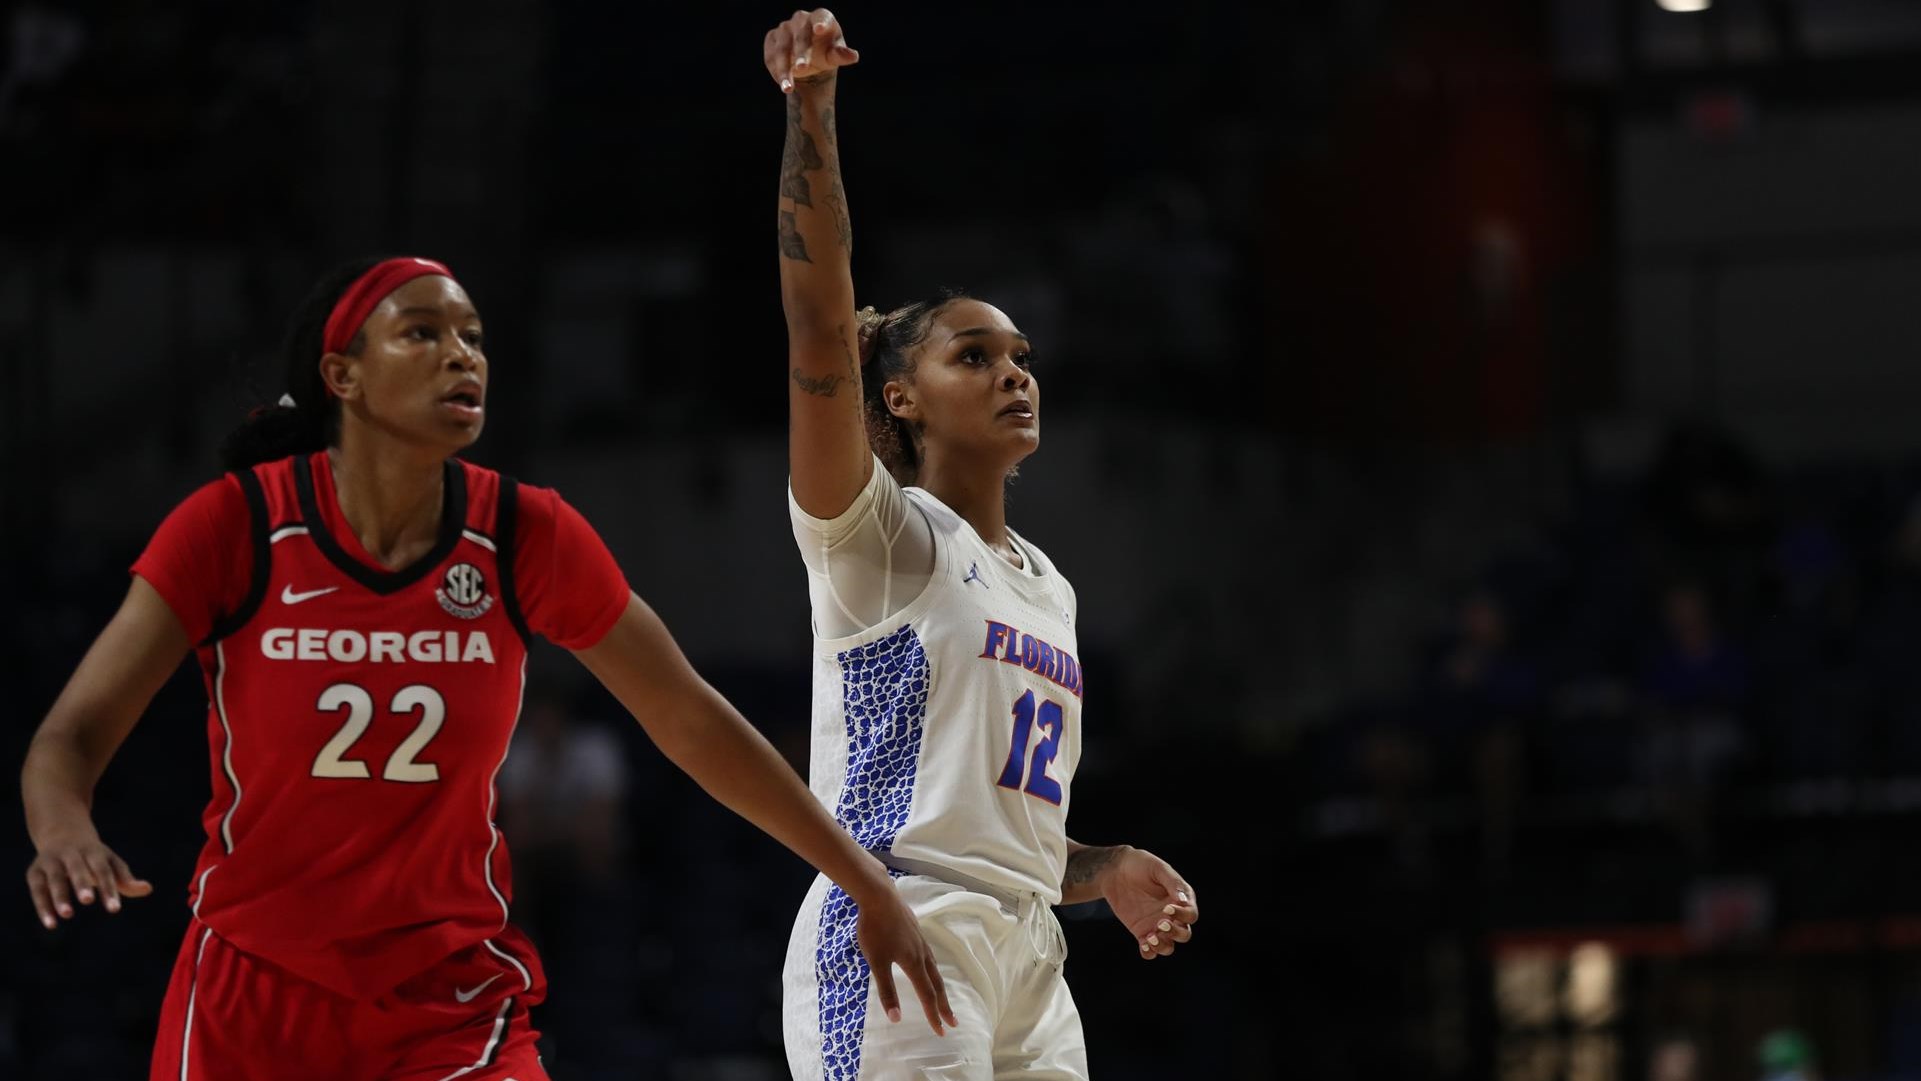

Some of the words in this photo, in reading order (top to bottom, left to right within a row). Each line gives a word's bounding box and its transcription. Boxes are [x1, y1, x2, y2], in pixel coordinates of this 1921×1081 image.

[446, 564, 483, 605] SEC
[261, 627, 496, 664] GEORGIA
[310, 682, 446, 783] 22
[997, 688, 1063, 806] 12
